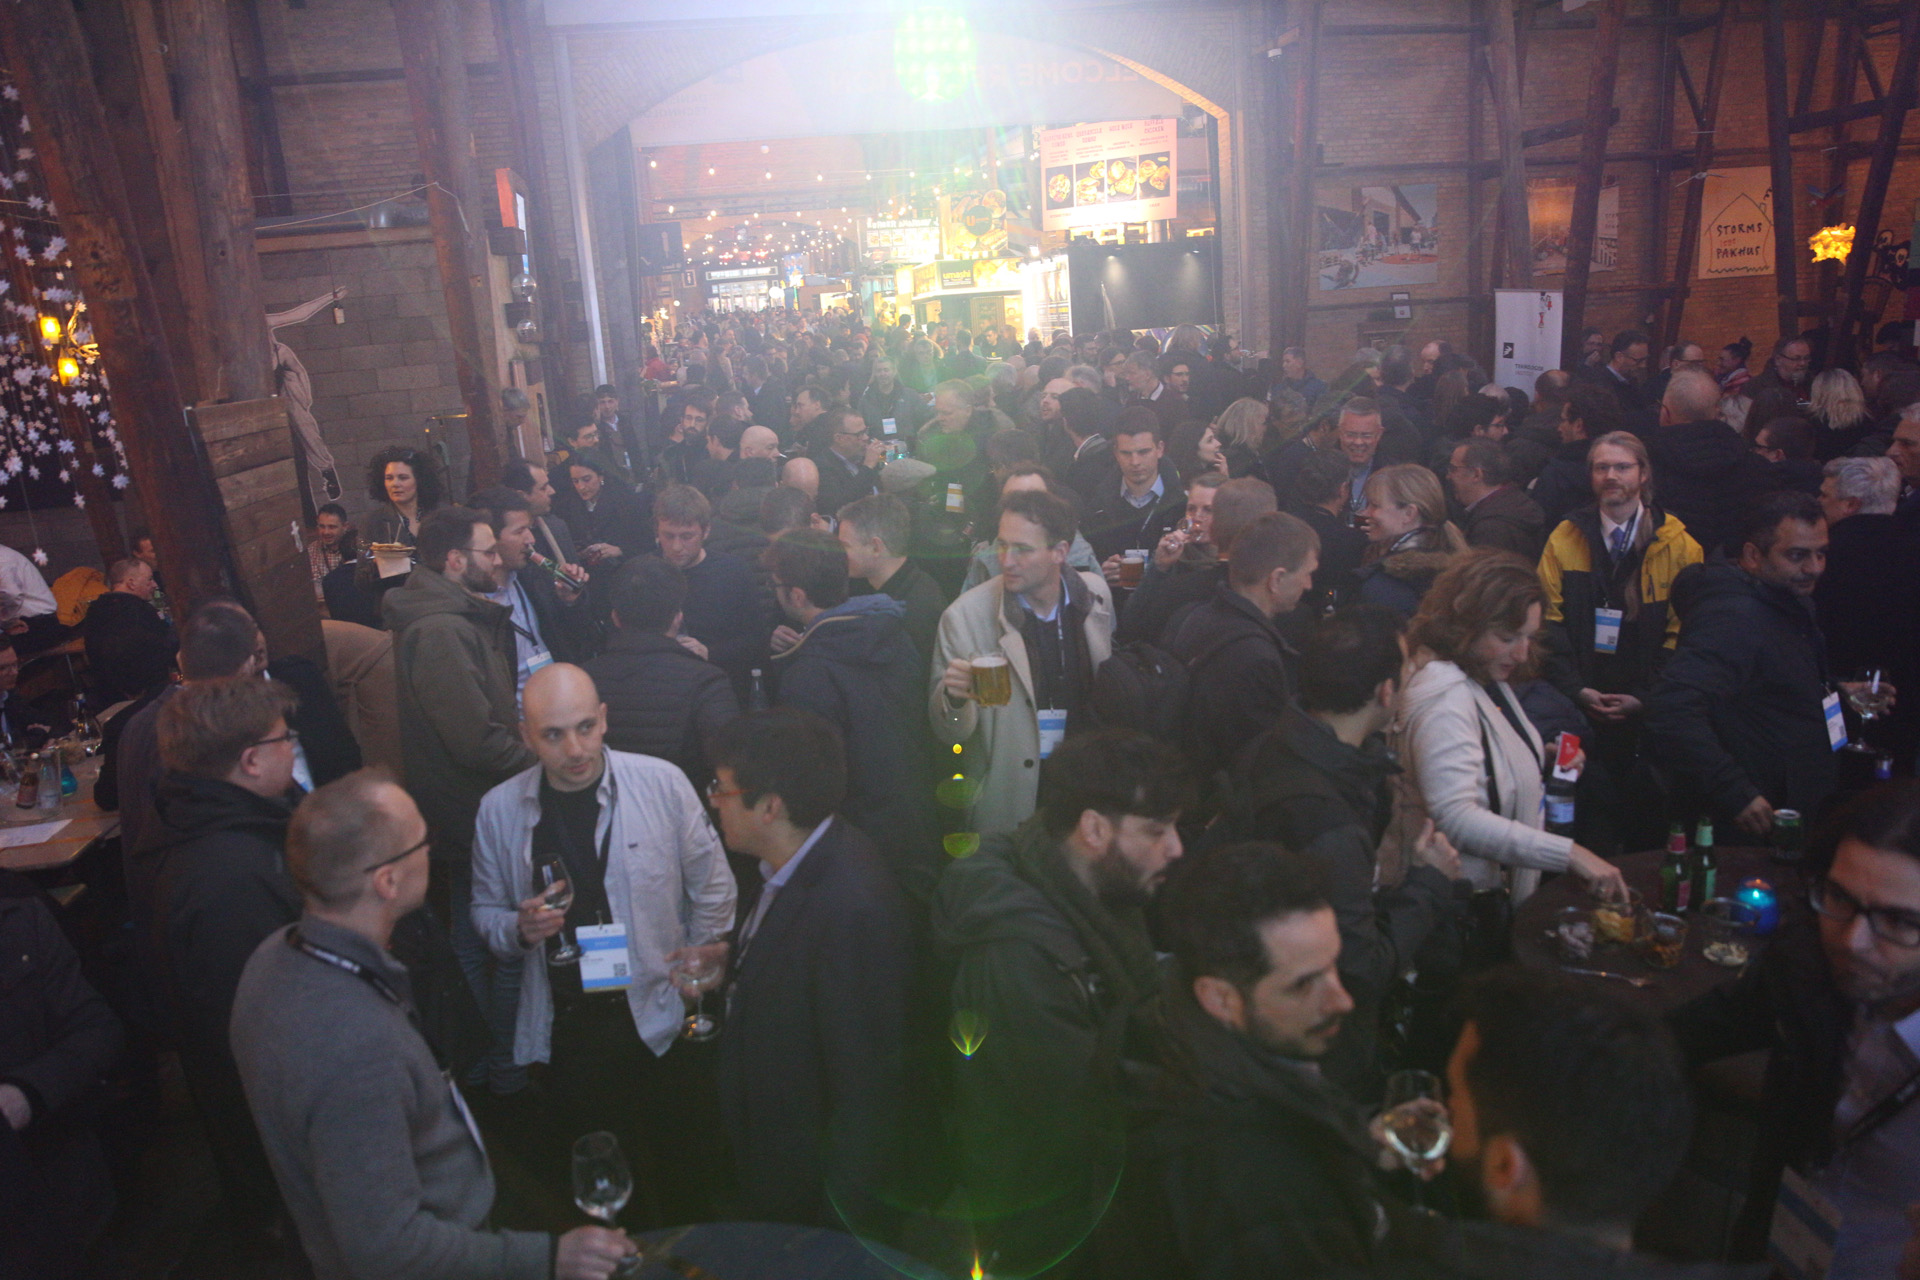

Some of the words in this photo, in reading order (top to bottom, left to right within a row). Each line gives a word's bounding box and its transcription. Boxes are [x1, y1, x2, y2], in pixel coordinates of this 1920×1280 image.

[1716, 222, 1763, 237] STORMS
[1716, 246, 1761, 259] PAKHUS
[943, 269, 971, 280] umashi
